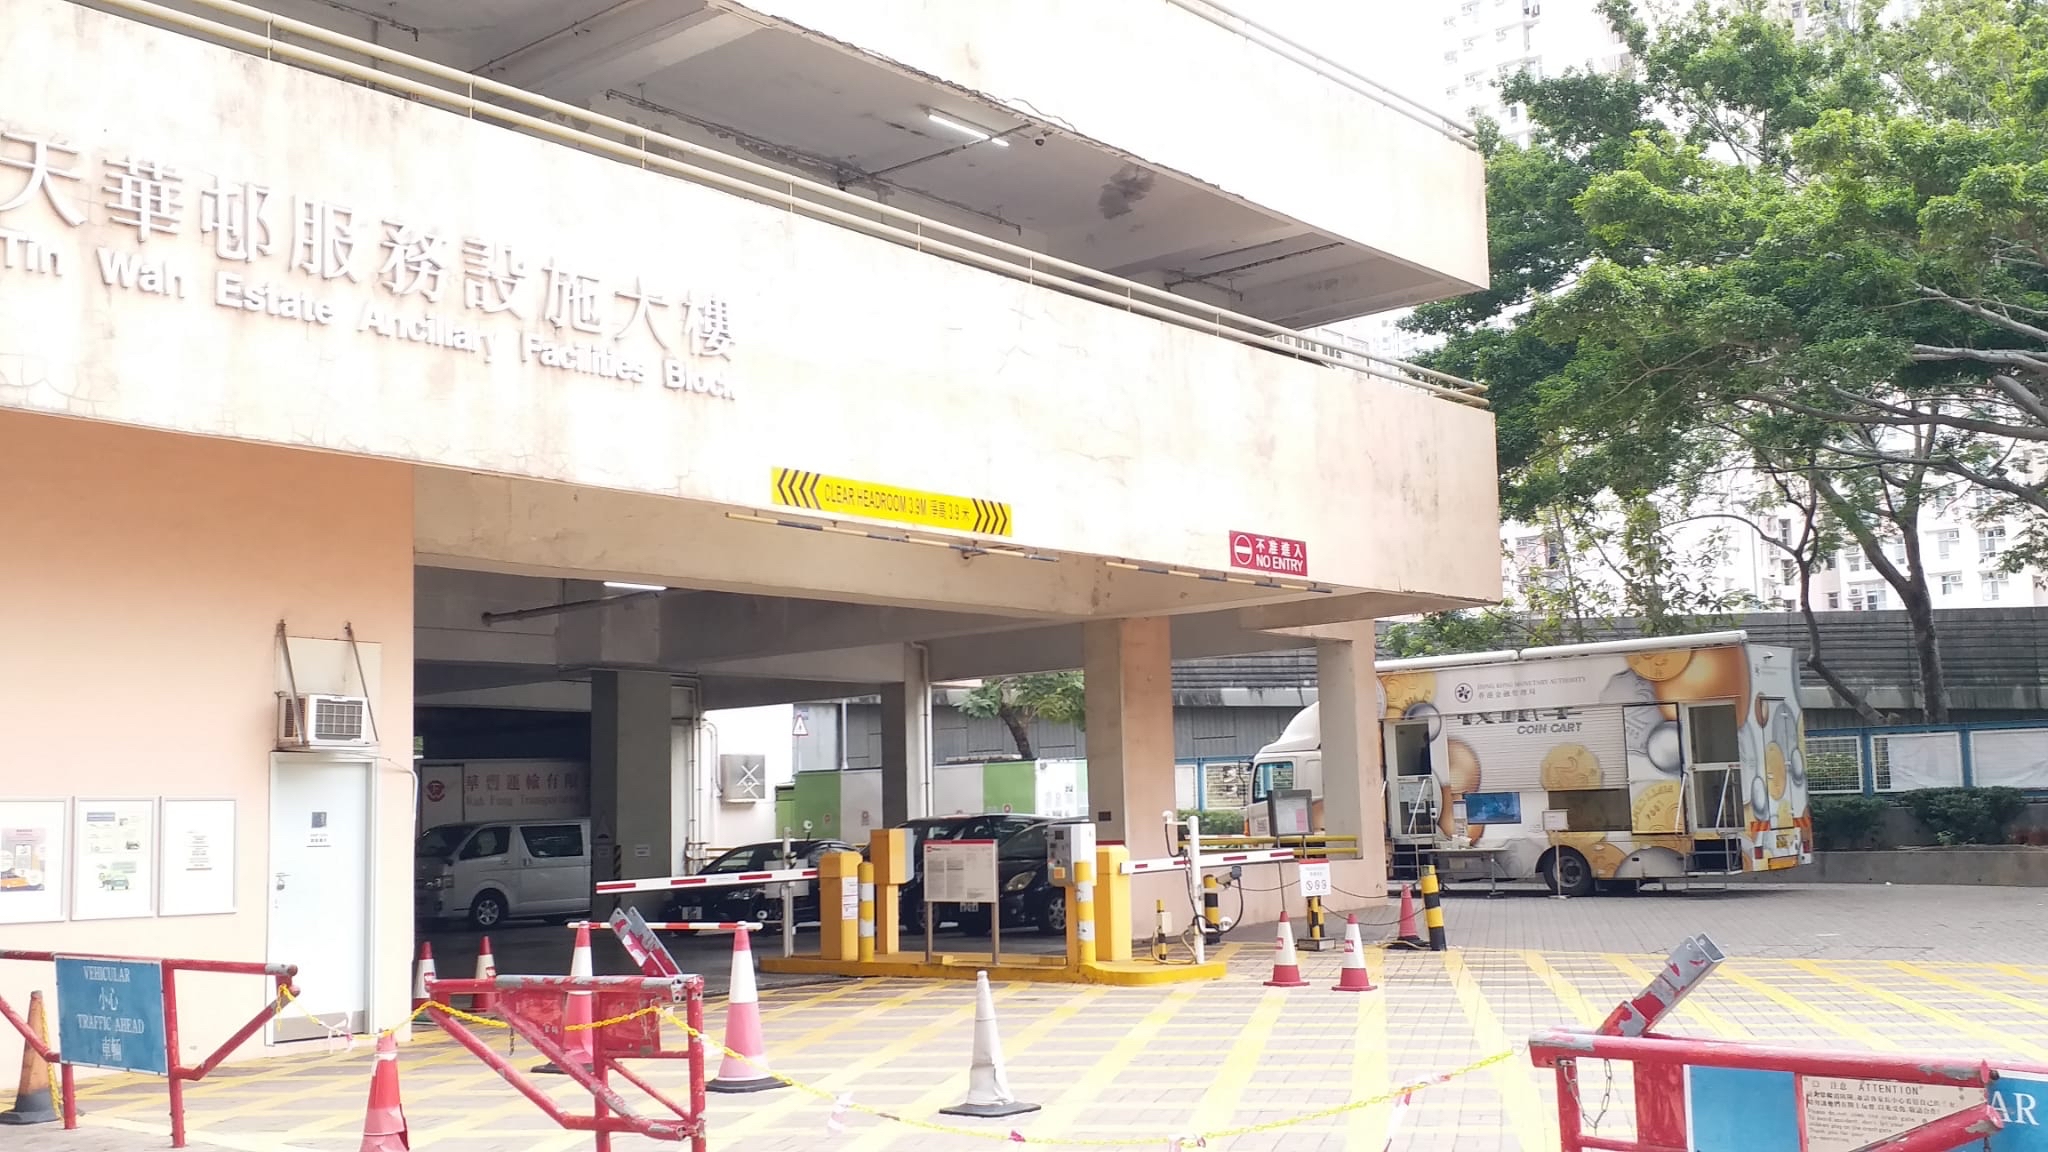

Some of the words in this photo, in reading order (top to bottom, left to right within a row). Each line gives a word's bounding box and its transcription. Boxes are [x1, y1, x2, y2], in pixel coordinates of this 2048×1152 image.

[0, 131, 737, 362] 天華邨服務設施大樓
[0, 227, 62, 277] Tin
[96, 246, 186, 299] Wah
[215, 270, 338, 325] Estate
[356, 300, 497, 364] Ancillary
[520, 327, 647, 384] Facilities
[663, 357, 736, 401] Block
[825, 482, 856, 506] CLEAR
[857, 487, 906, 513] HEADROOM
[1256, 553, 1271, 568] NO
[1273, 556, 1303, 572] ENTRY
[1517, 724, 1547, 735] COIN
[1551, 722, 1582, 733] CART
[83, 965, 130, 982] VEHICULAR
[98, 986, 118, 1011] 小心
[77, 1013, 112, 1031] TRAFFIC
[115, 1018, 144, 1034] AHEAD
[1859, 1083, 1919, 1095] ATTENTION
